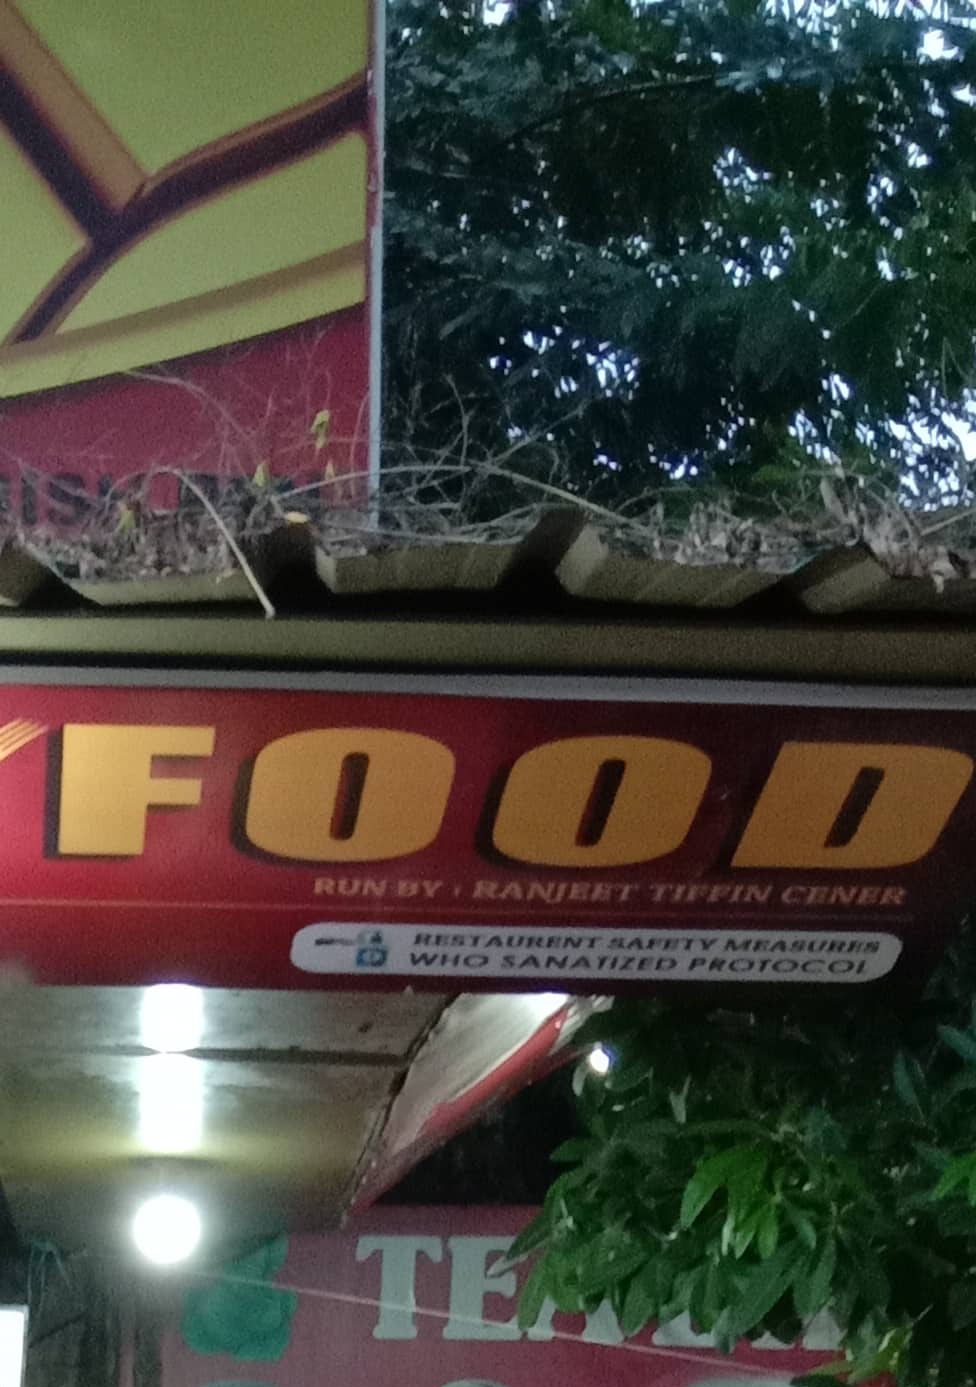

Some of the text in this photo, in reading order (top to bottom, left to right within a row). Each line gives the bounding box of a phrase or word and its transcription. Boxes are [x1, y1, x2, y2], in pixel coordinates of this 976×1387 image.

[58, 722, 975, 870] FOOD
[313, 877, 387, 897] RUN
[397, 879, 442, 898] BY
[474, 880, 641, 904] RANJEET
[649, 883, 773, 903] TIFFIN
[781, 885, 908, 906] CENER
[413, 932, 880, 954] RESTAURENT SAFETY MEASURES
[410, 952, 489, 969] WHO
[501, 953, 677, 972] SANATIZED
